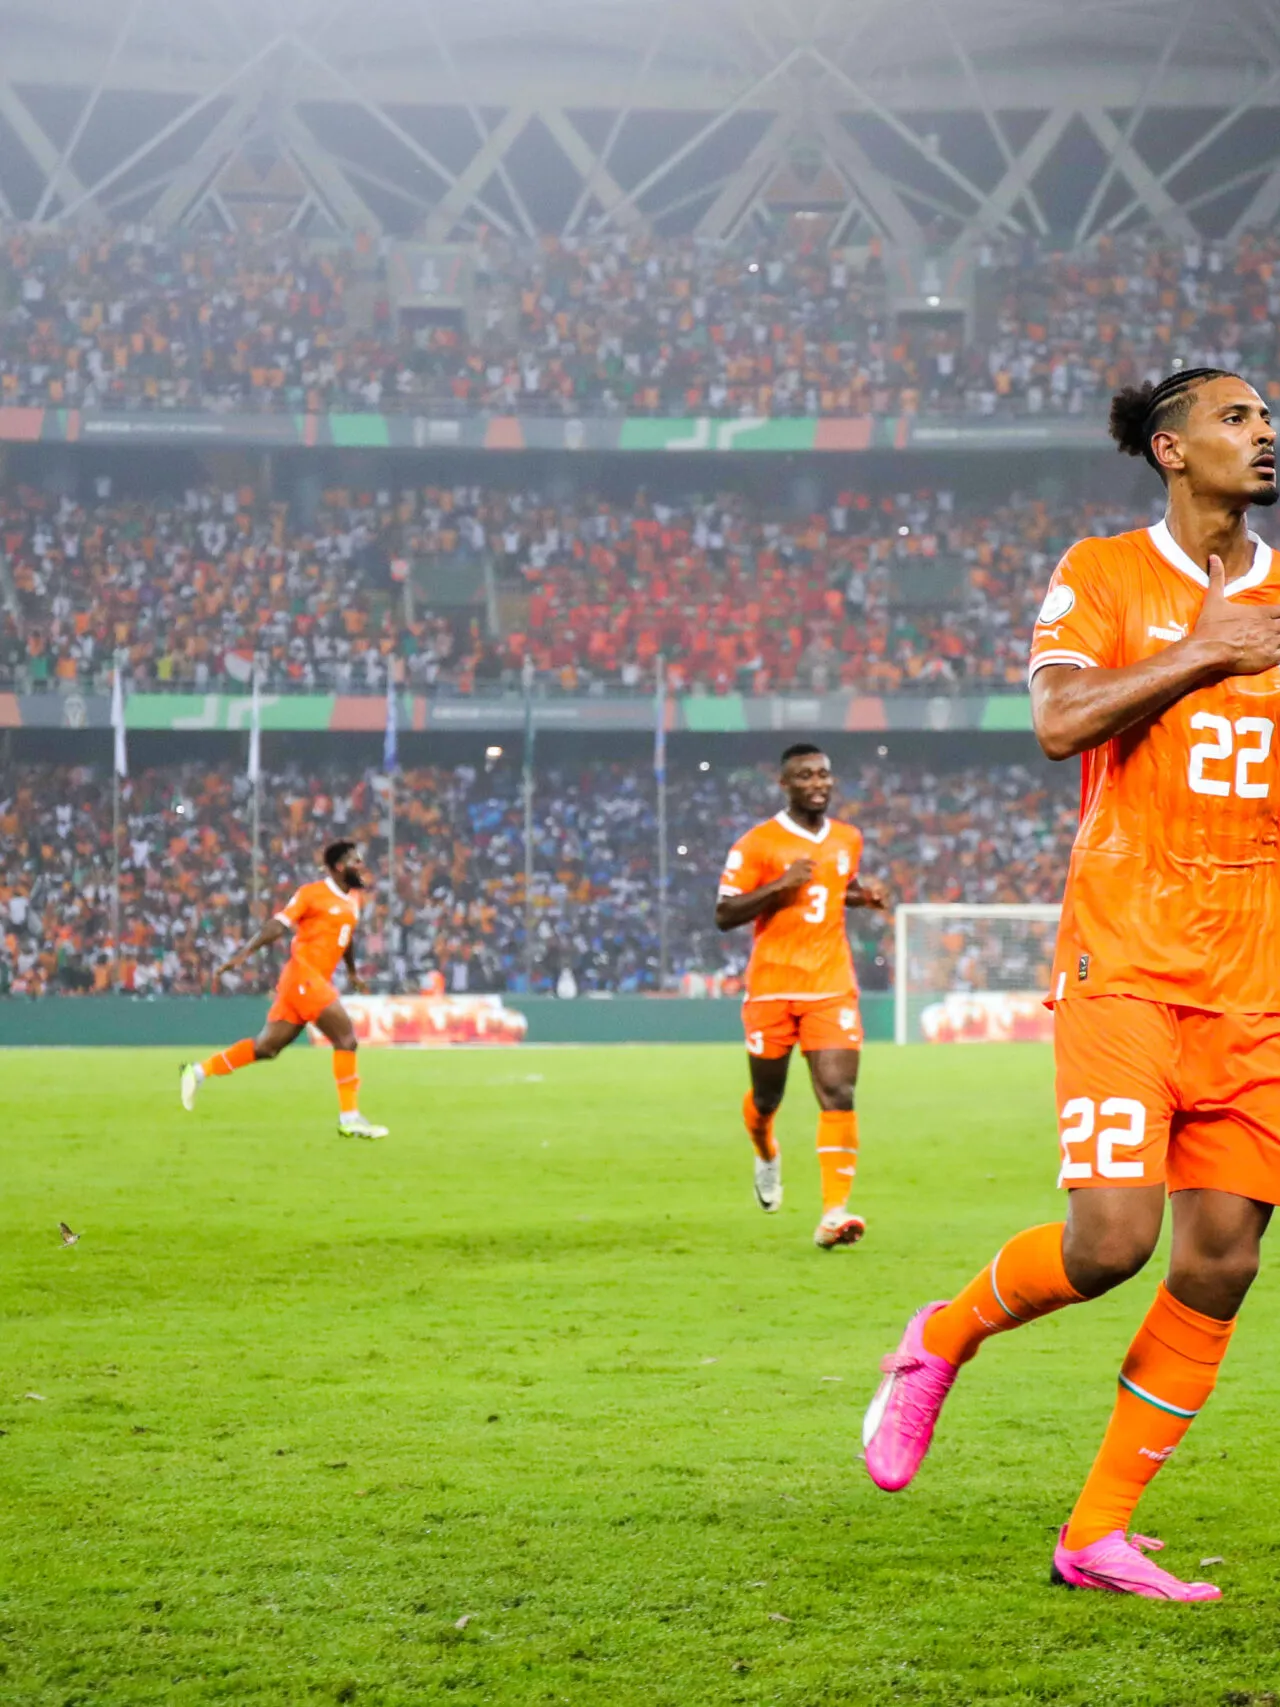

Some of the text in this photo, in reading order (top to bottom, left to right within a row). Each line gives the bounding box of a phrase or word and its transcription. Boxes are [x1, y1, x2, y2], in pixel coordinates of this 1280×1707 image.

[1189, 711, 1275, 798] 22
[804, 885, 828, 923] 3
[1060, 1096, 1146, 1178] 22
